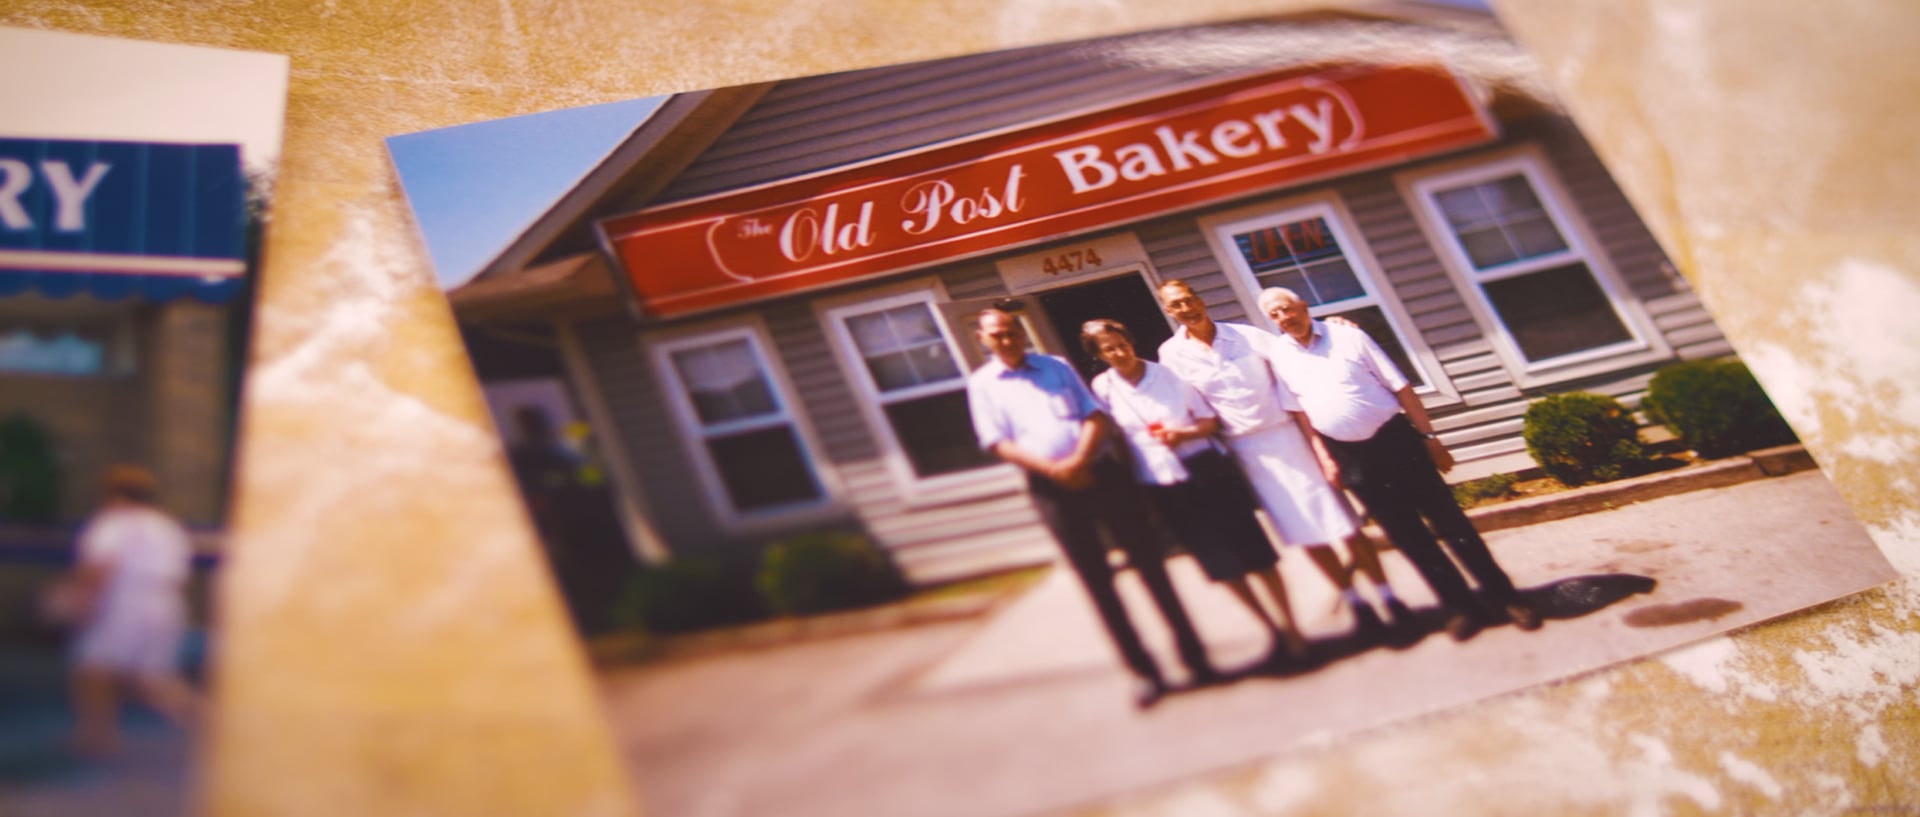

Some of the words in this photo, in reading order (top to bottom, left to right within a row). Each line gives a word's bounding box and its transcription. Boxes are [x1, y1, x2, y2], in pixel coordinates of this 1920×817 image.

[737, 217, 773, 240] The
[778, 201, 876, 262] Old
[900, 164, 1027, 235] Post
[1053, 97, 1334, 194] Bakery
[1042, 248, 1102, 276] 4474
